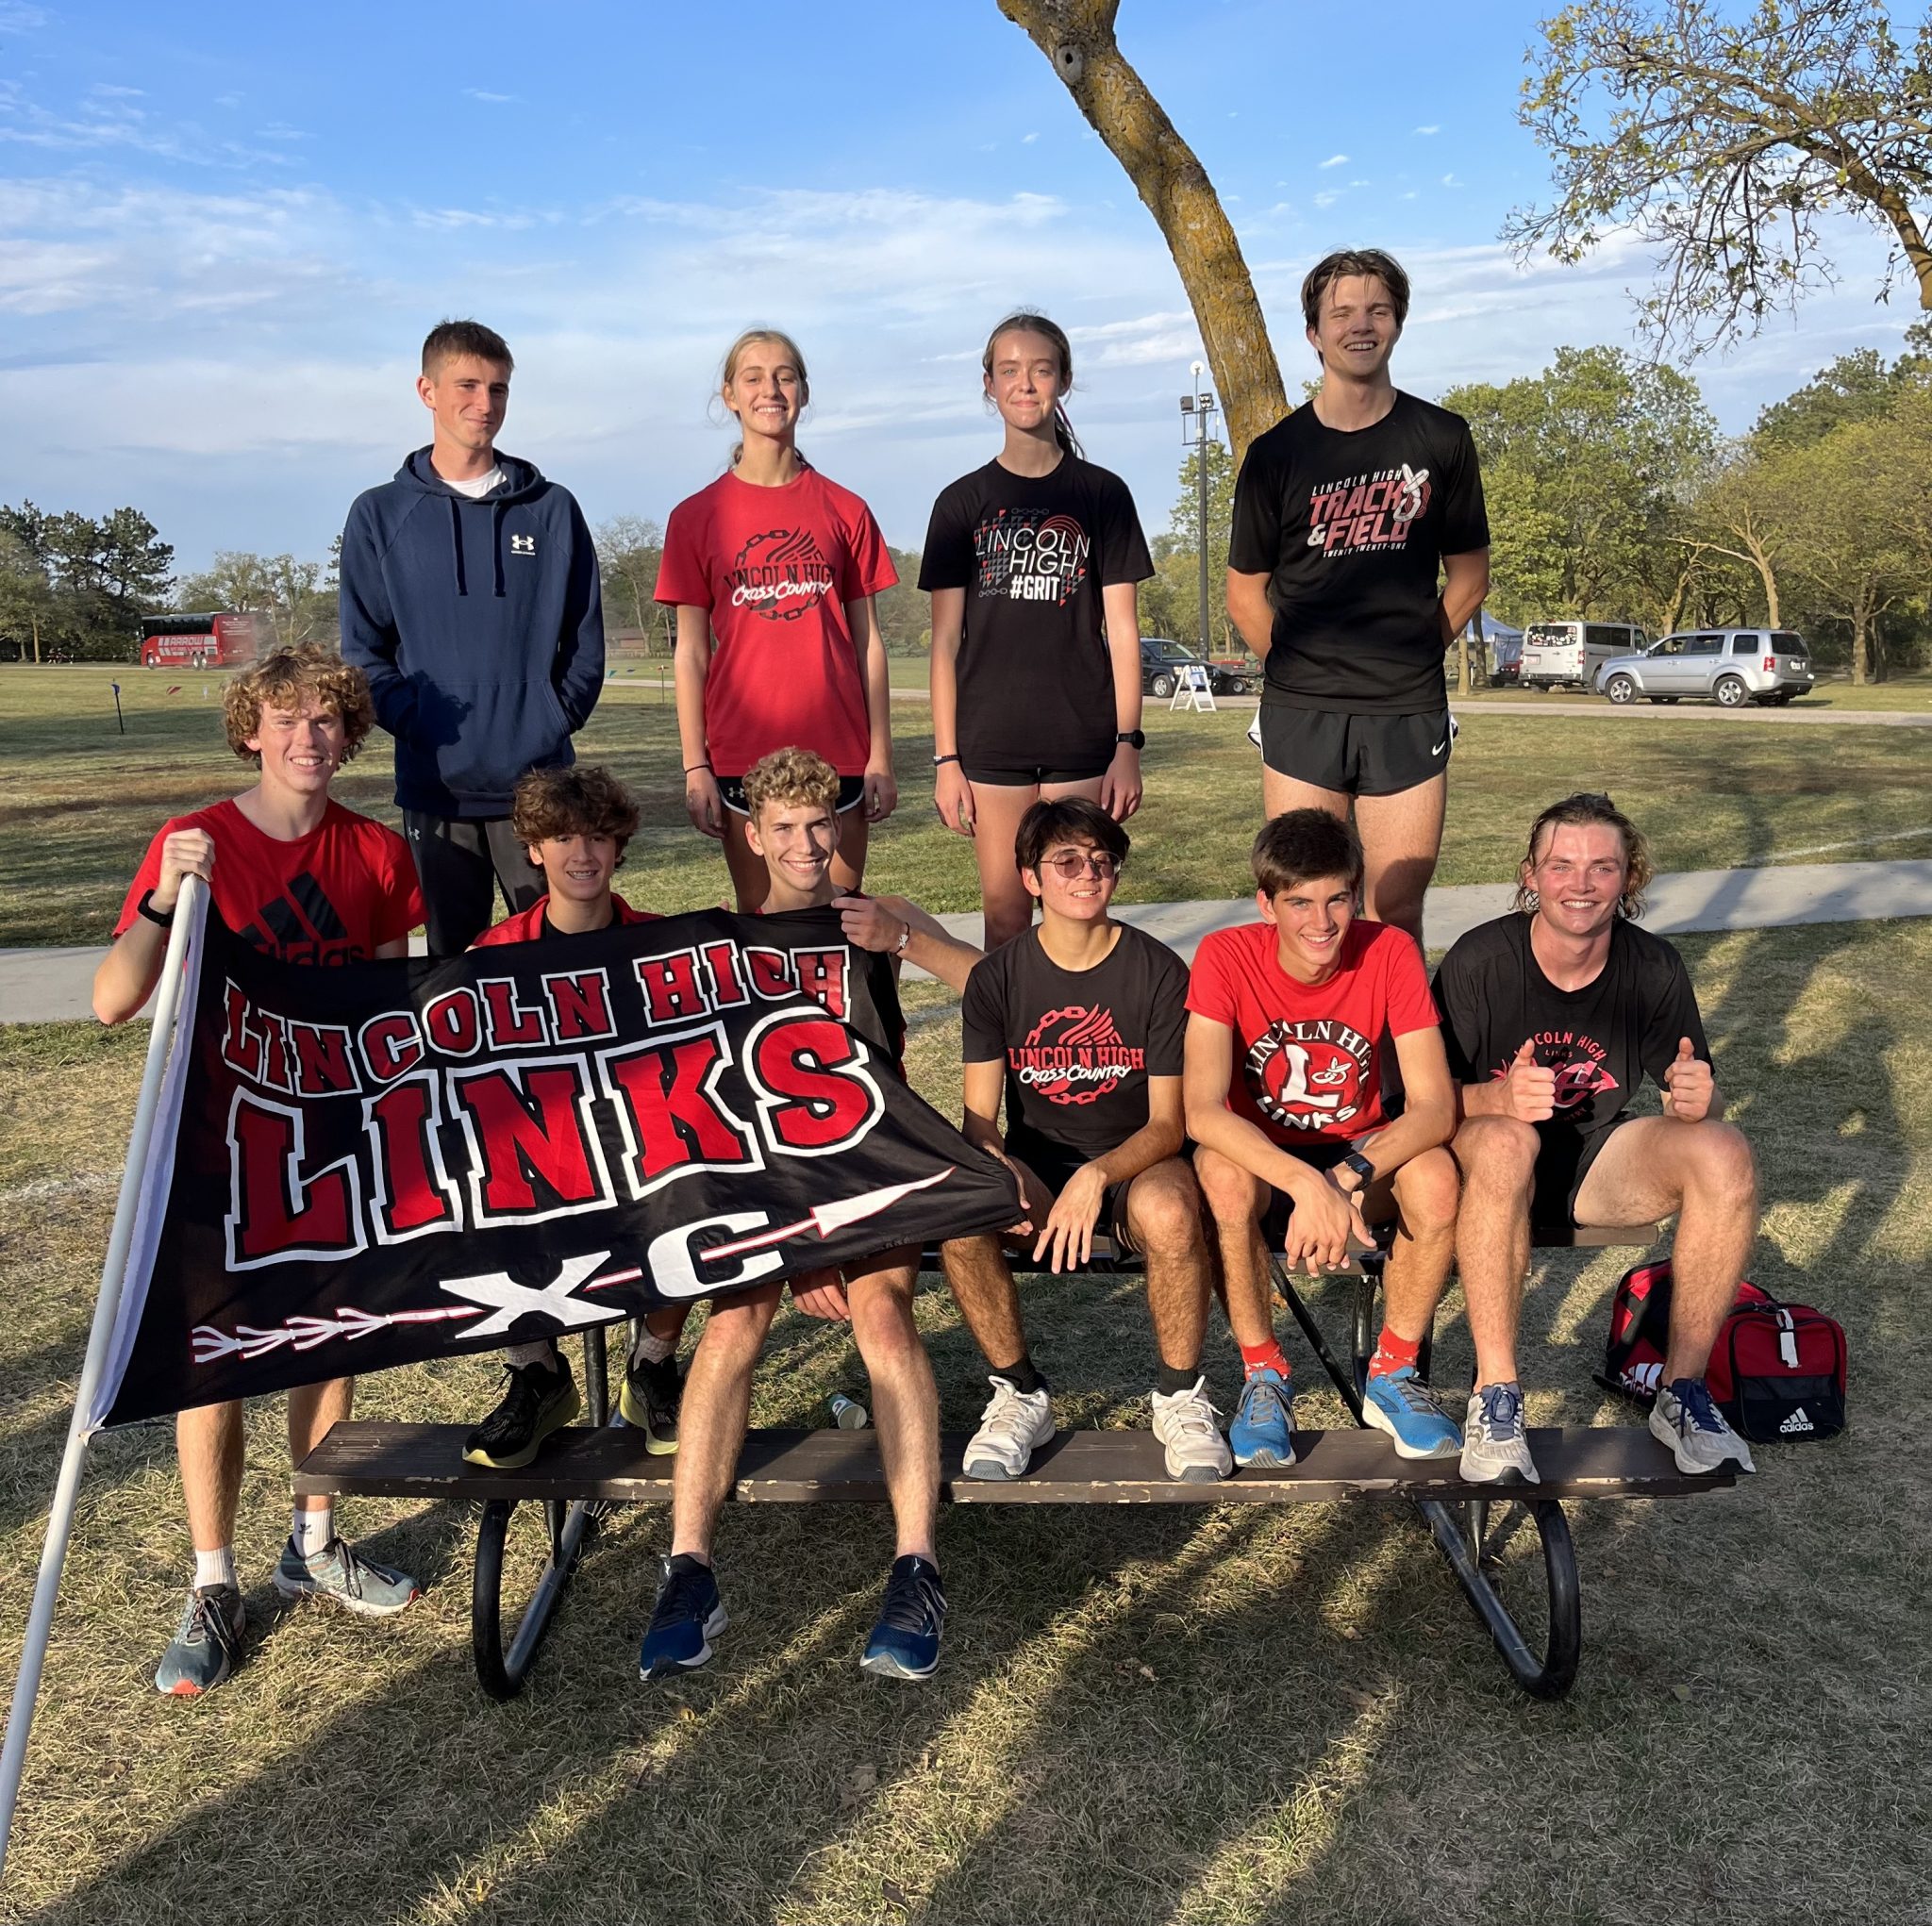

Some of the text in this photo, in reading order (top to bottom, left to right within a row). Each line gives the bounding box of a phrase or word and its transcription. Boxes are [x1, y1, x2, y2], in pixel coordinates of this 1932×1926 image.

[1312, 470, 1403, 497] LINCOLN HIGH
[1309, 480, 1407, 526] TRACK
[975, 528, 1091, 558] LINCOLN
[1307, 512, 1411, 551] & FIELD
[1008, 550, 1078, 578] HIGH
[732, 579, 833, 606] CROSS COUNTRY
[1009, 574, 1060, 601] #GRIT
[222, 968, 619, 1098] LINCOLN
[1008, 1045, 1144, 1071] LINCOLN HIGH
[1576, 1034, 1607, 1061] HIGH
[1019, 1064, 1132, 1084] CROSS COUNTRY
[1257, 1095, 1357, 1131] LINKS
[225, 1005, 886, 1272] LINKS
[1779, 1421, 1815, 1434] adidas
